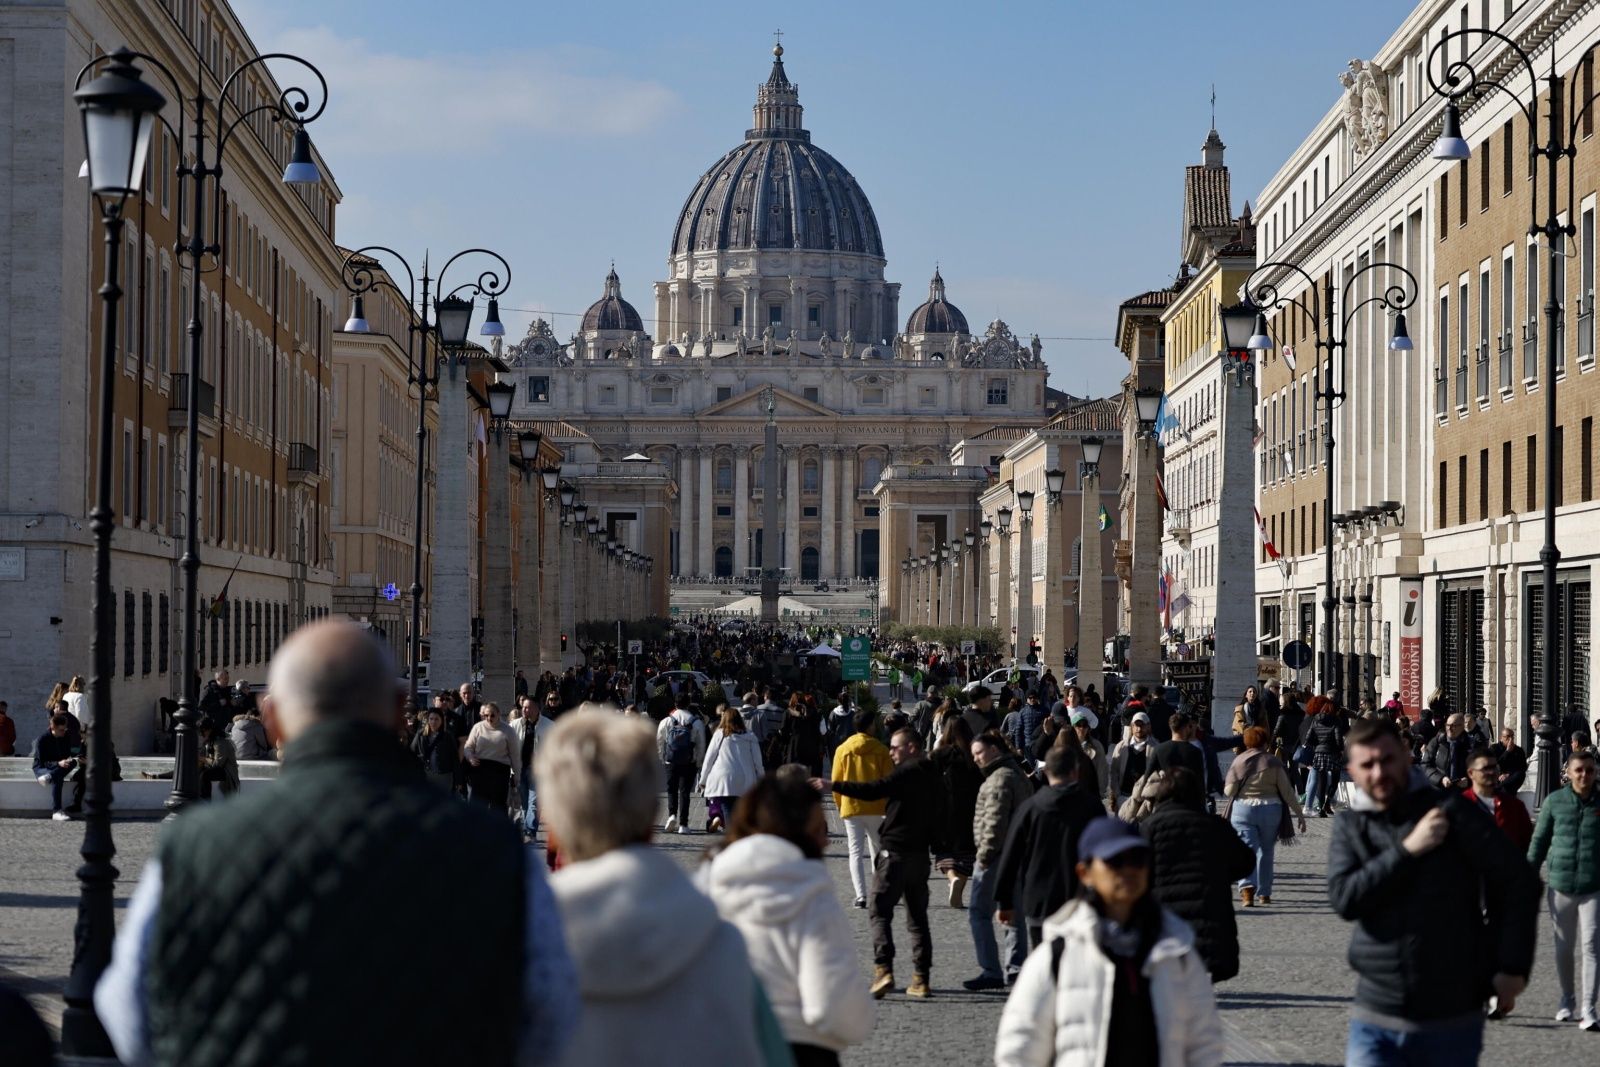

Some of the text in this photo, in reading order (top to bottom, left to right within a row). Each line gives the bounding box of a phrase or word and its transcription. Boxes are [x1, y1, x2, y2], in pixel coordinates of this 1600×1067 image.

[1403, 589, 1419, 627] i
[1401, 643, 1410, 706] TOURIST
[1410, 643, 1419, 708] INFOPOINT
